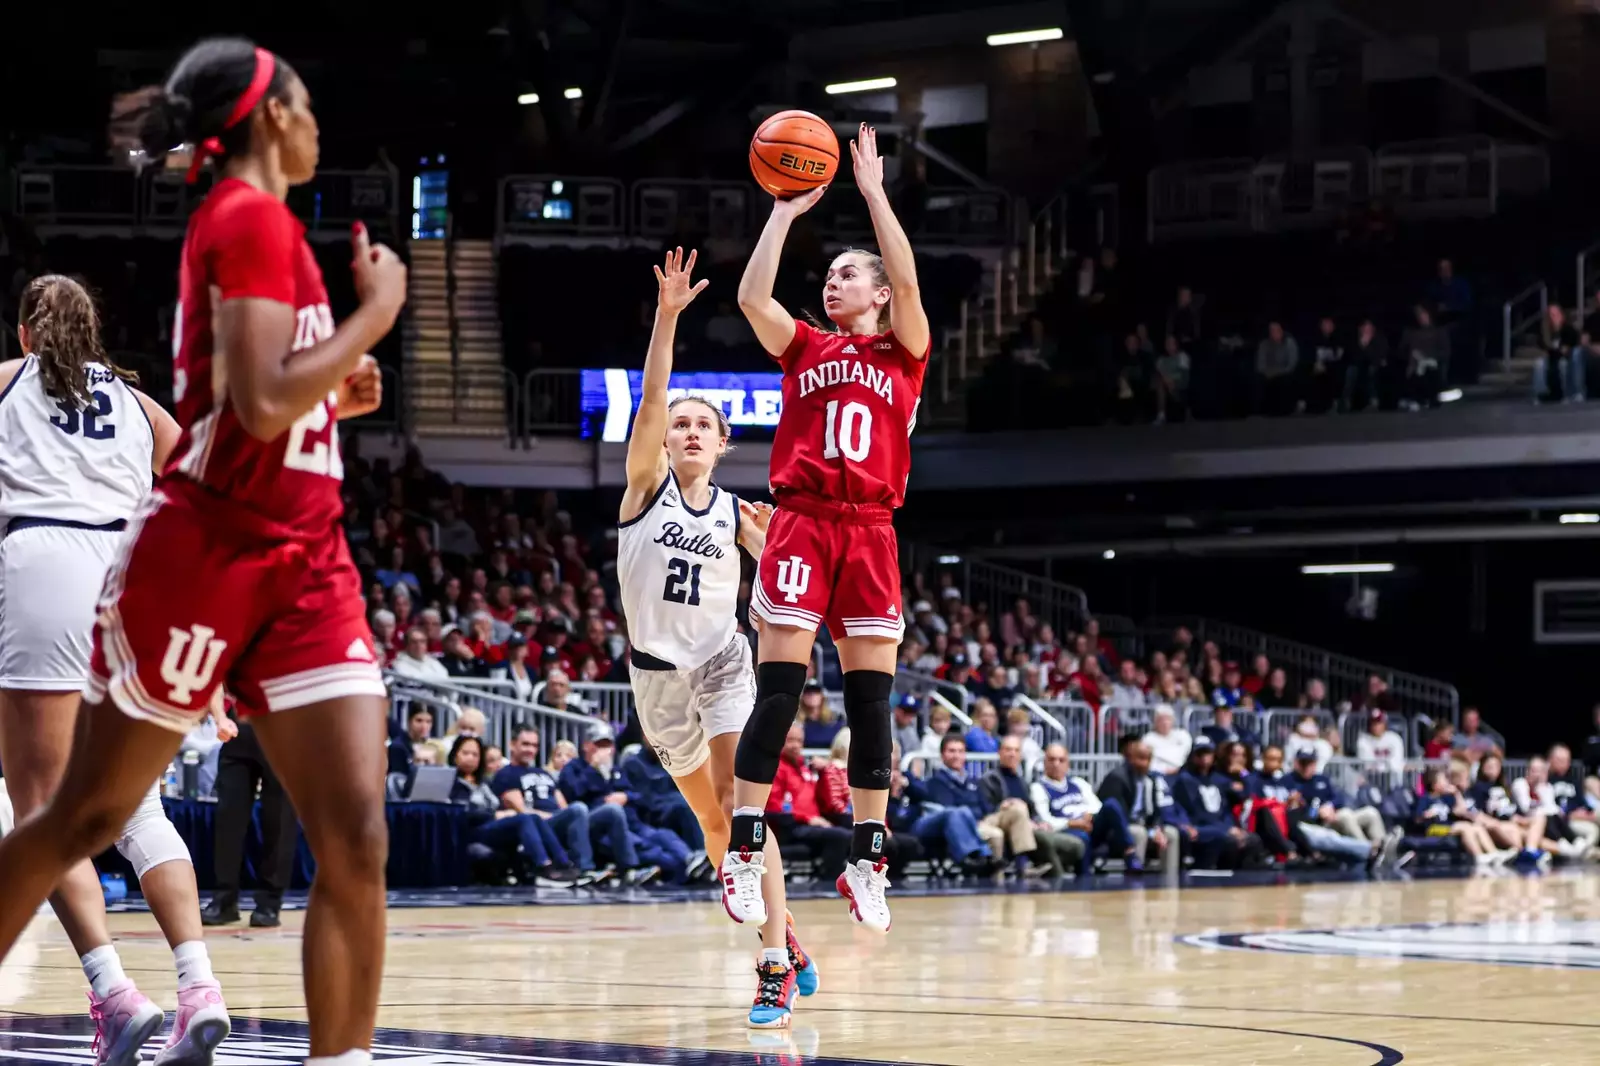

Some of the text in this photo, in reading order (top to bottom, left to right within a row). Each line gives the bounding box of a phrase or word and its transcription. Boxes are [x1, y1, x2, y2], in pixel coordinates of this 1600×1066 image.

[779, 152, 827, 176] ELITE
[798, 359, 893, 406] INDIANA
[823, 399, 873, 463] 10
[653, 521, 725, 560] Butler
[662, 556, 703, 606] 21
